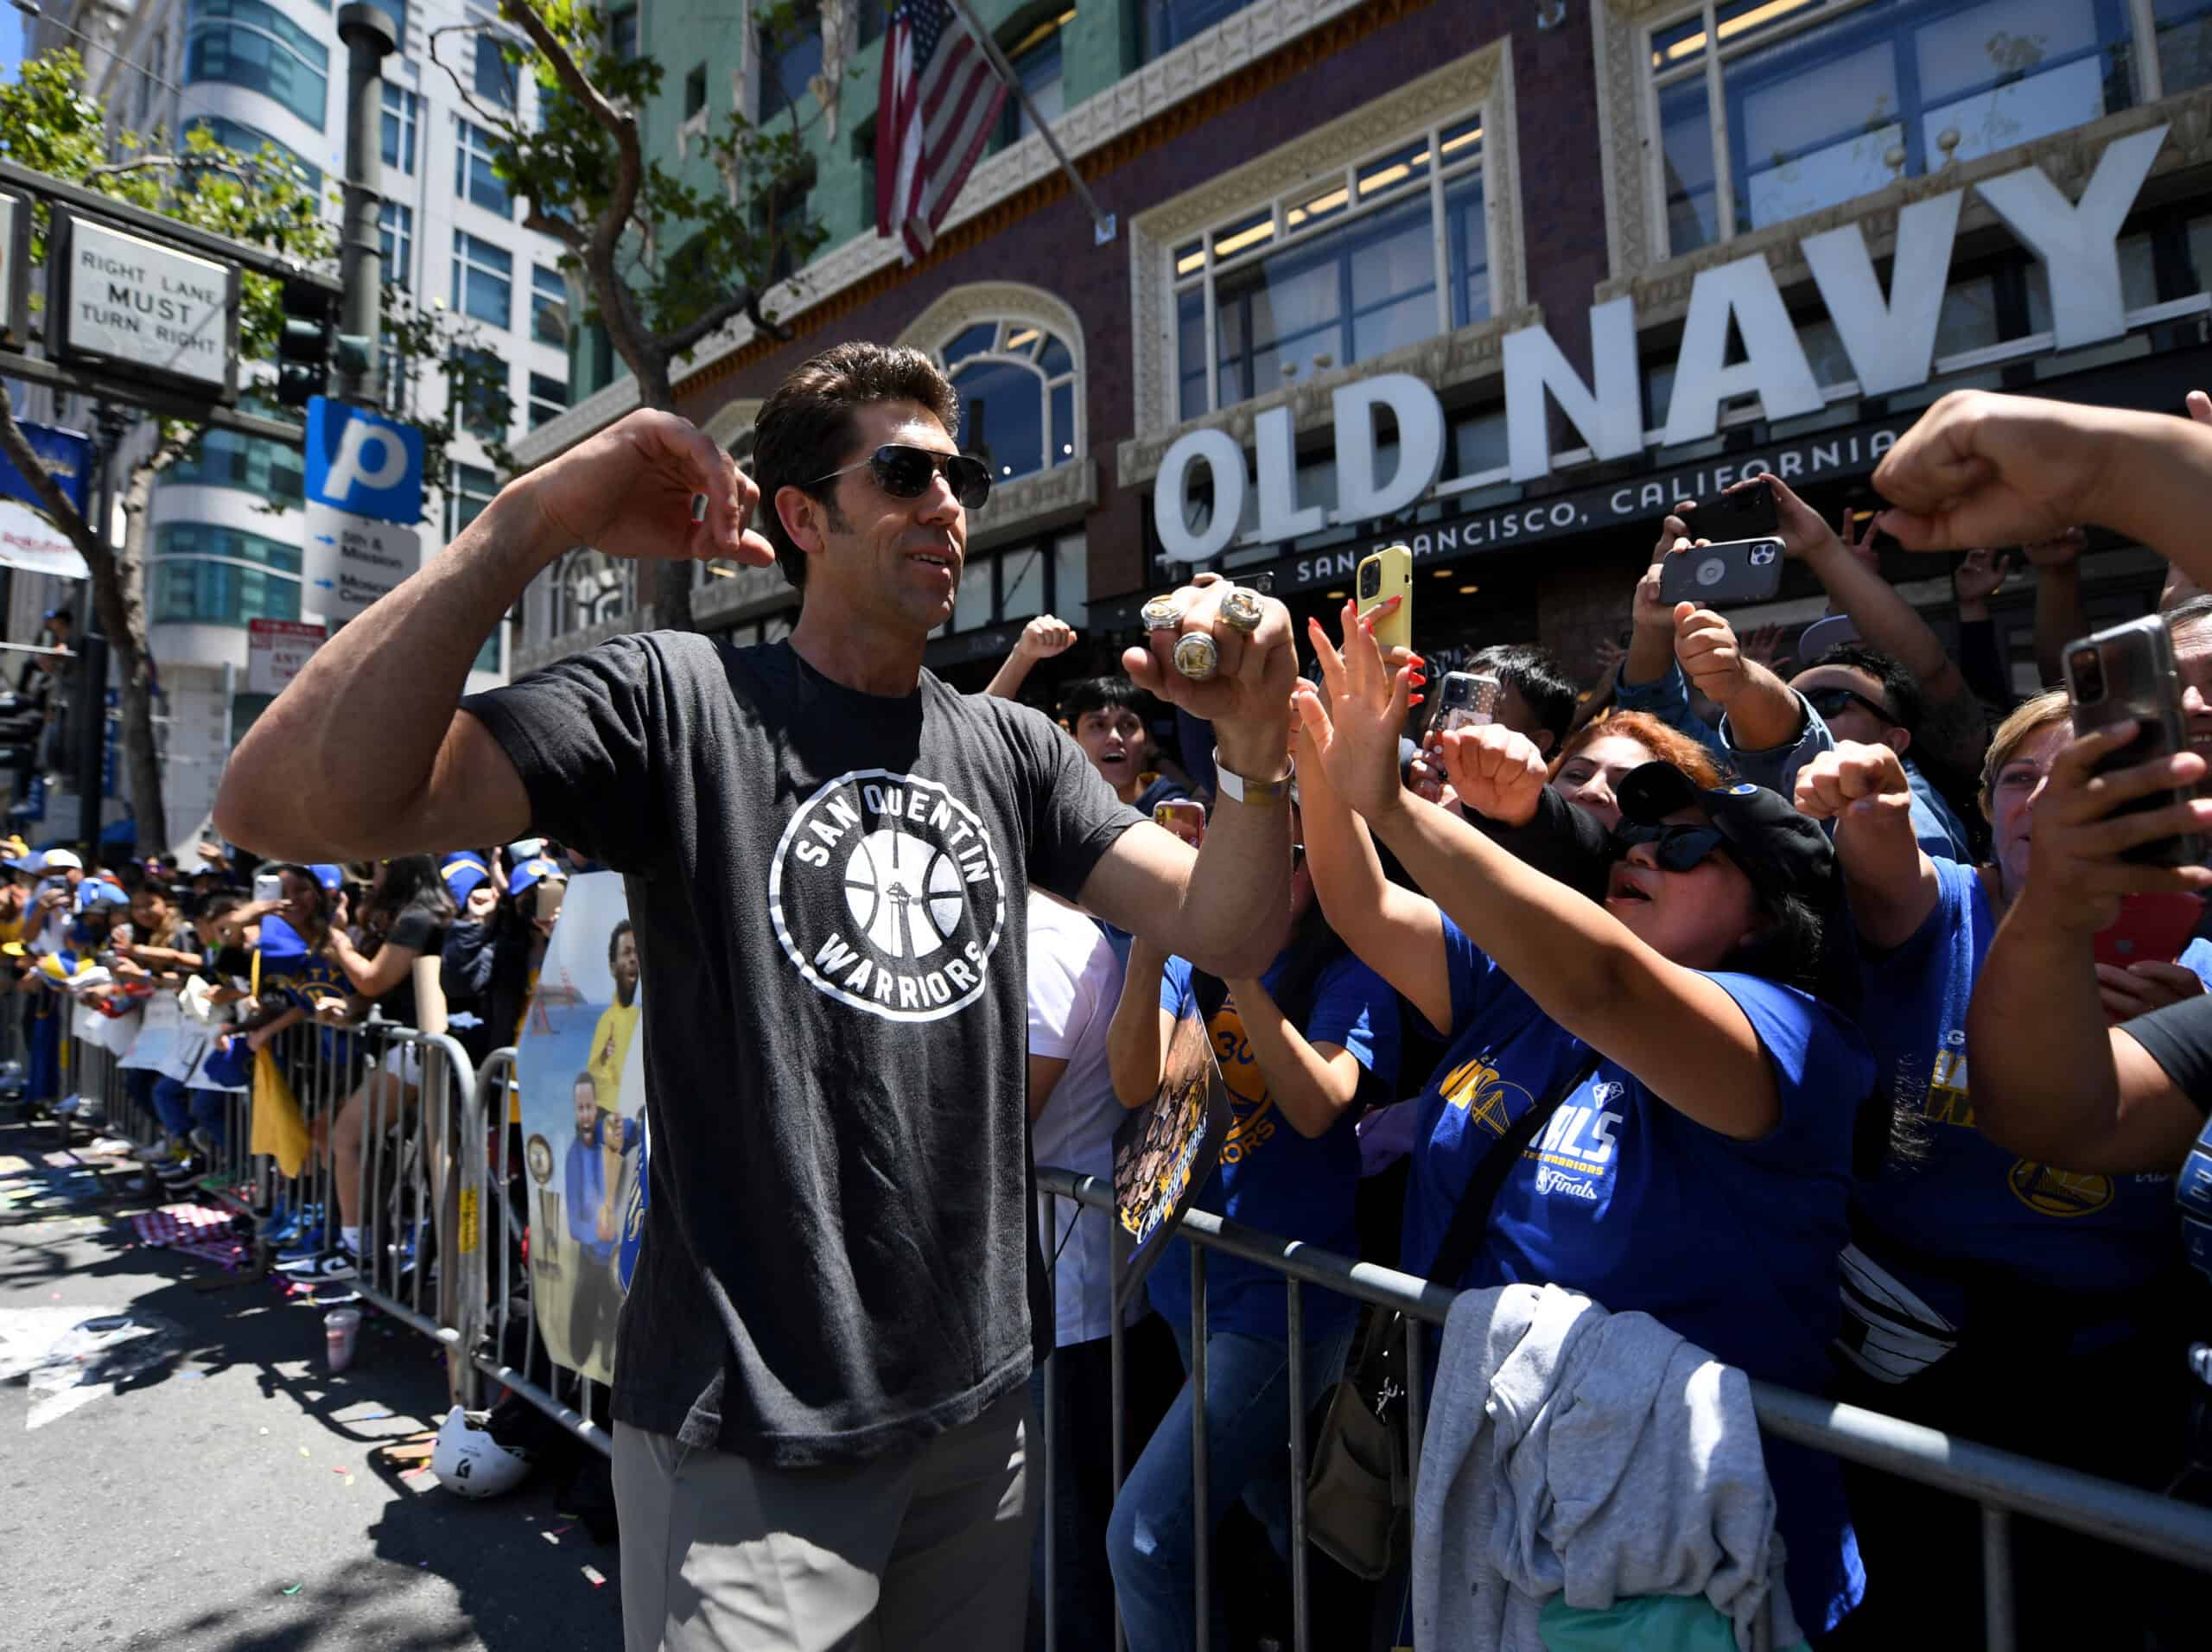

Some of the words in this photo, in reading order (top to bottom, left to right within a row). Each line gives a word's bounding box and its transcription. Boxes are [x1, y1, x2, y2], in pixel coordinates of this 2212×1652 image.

[81, 250, 145, 283] RIGHT
[162, 276, 216, 303] LANE
[109, 283, 190, 324] MUST
[82, 303, 139, 333] TURN
[156, 325, 215, 354] RIGHT
[1154, 372, 1444, 563] OLD
[1503, 124, 2171, 484] NAVY
[1298, 550, 1356, 582] SAN
[1372, 503, 1590, 558] ANCISCO,
[1611, 430, 1898, 514] CALIFORNIA
[796, 796, 860, 867] SAN
[863, 785, 990, 883] QUENTIN
[815, 932, 988, 1009] WARRIORS
[1541, 1170, 1598, 1199] Finals
